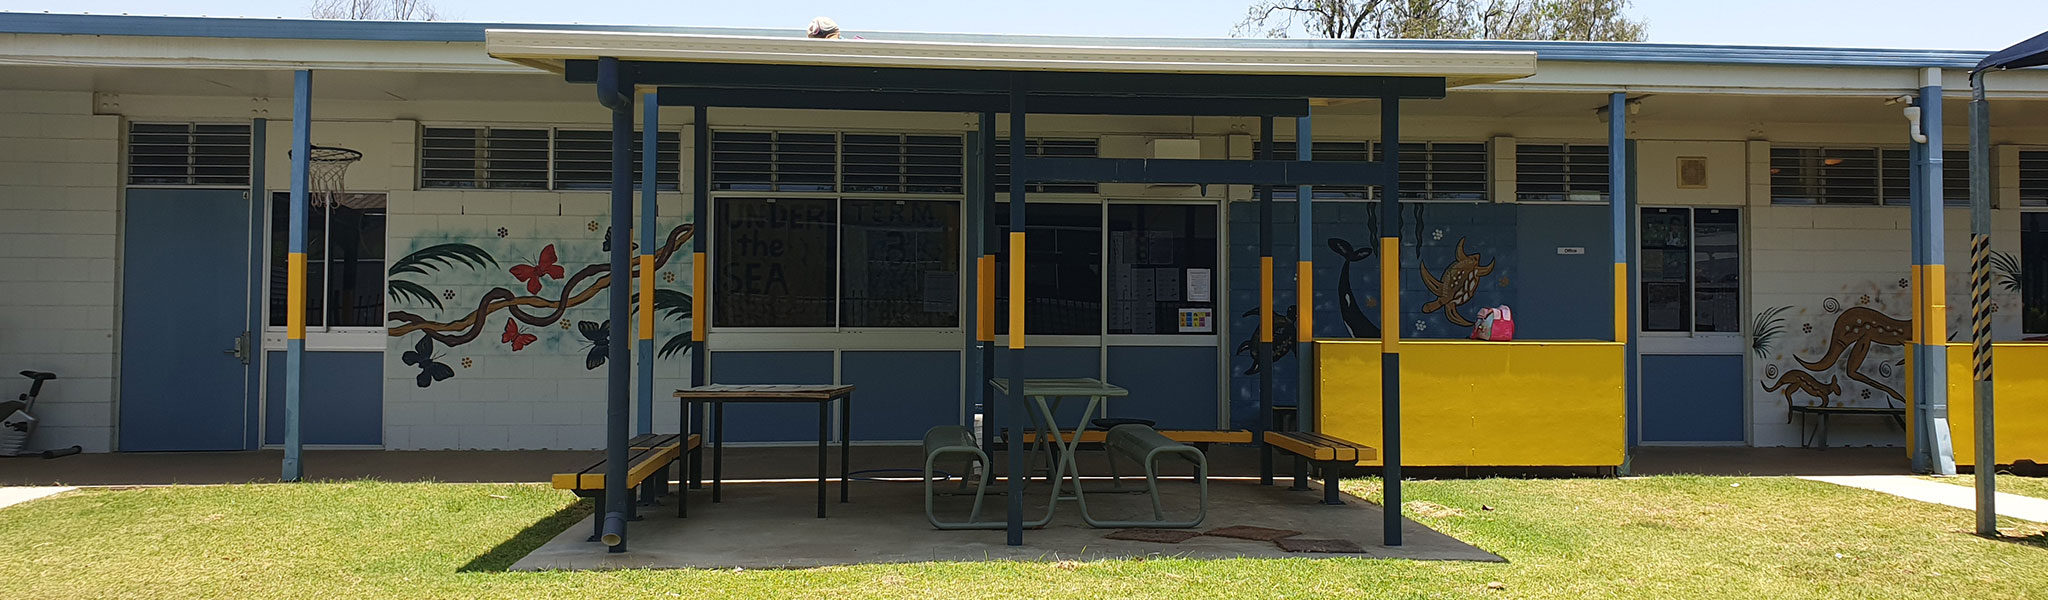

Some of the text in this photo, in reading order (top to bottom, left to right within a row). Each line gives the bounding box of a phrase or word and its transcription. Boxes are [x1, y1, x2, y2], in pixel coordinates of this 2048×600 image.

[724, 202, 825, 229] UNDER
[851, 202, 934, 223] TERM
[736, 229, 785, 256] the
[723, 262, 789, 295] SEA
